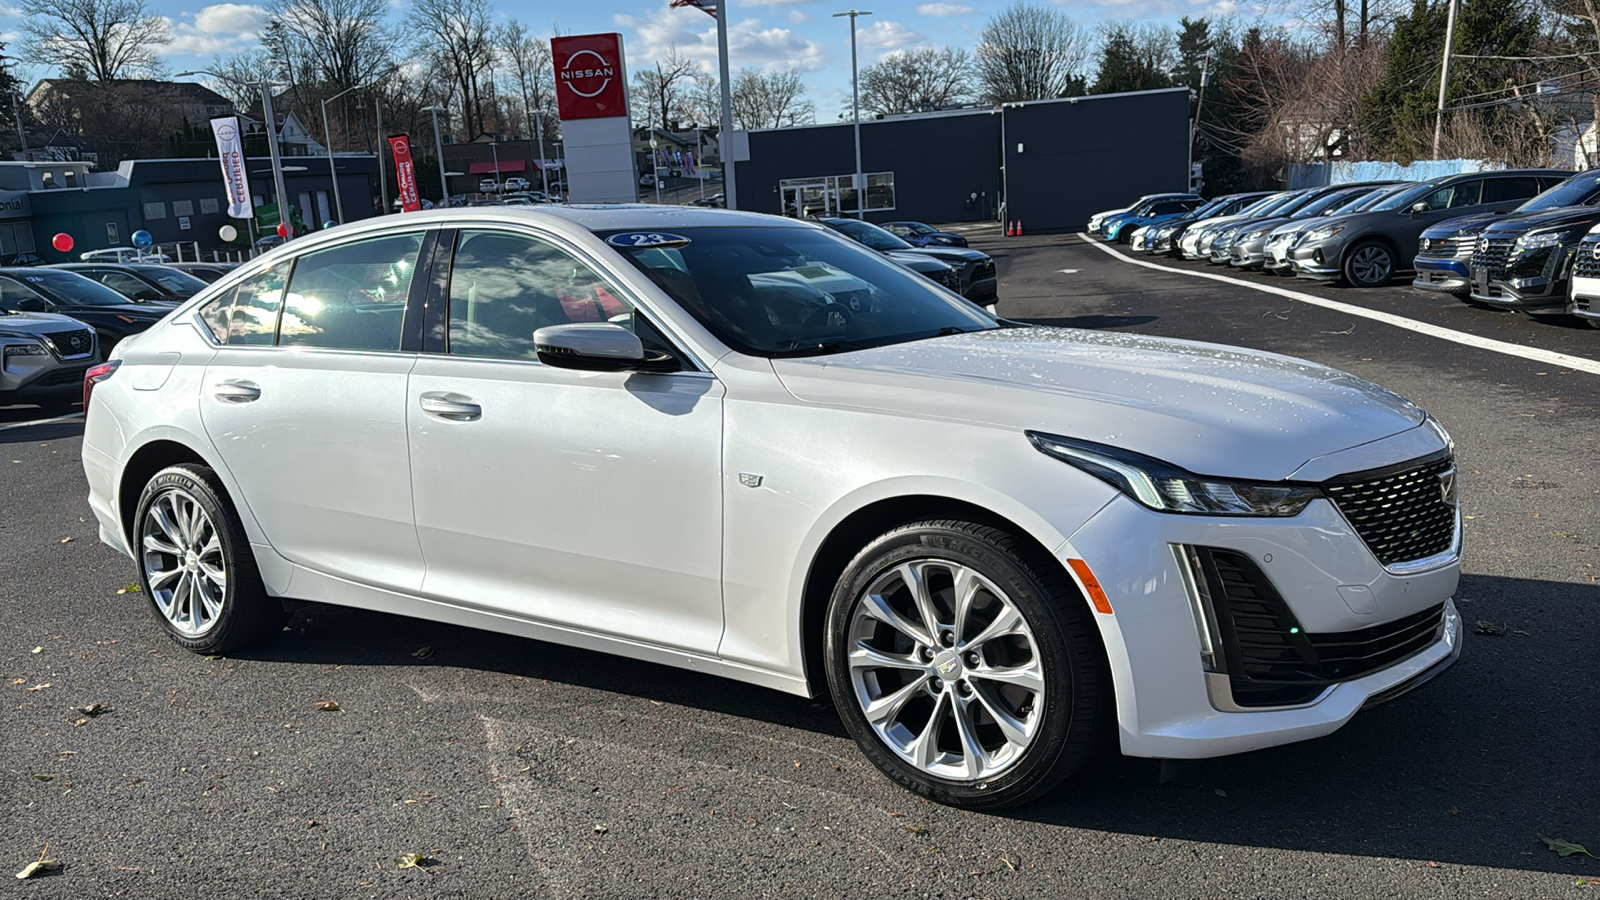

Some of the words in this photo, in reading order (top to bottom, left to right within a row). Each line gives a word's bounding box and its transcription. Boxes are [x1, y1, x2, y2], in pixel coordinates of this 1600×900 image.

[561, 67, 613, 79] NISSAN
[630, 234, 665, 246] 23
[157, 475, 194, 489] MICHELIN
